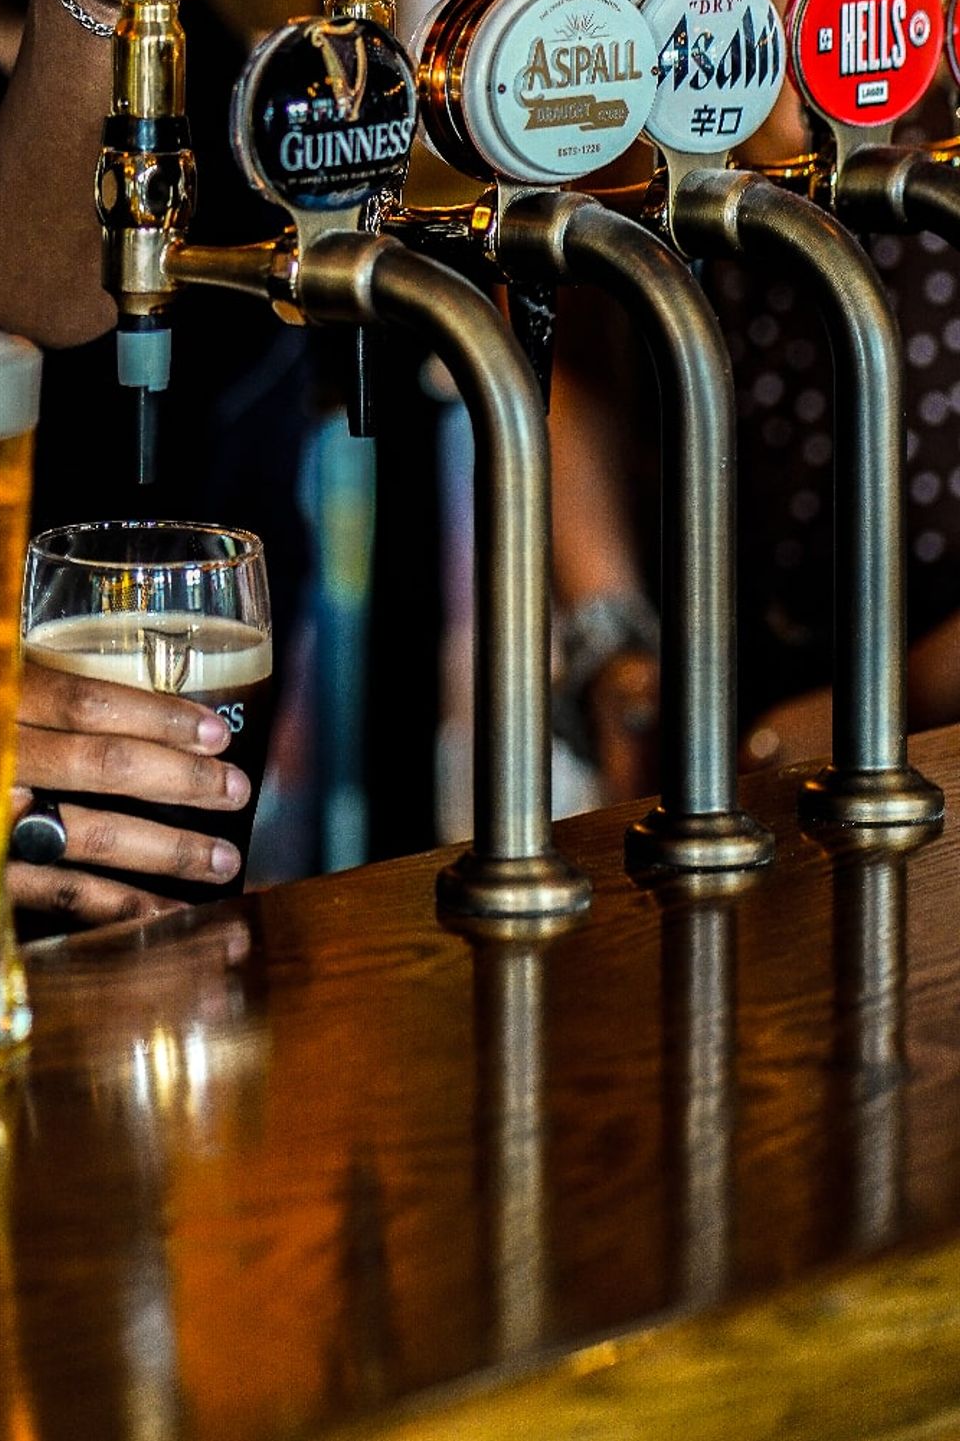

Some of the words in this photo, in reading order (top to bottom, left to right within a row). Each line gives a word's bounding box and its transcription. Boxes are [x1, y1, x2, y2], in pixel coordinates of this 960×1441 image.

[518, 37, 643, 91] ASPALL
[656, 5, 780, 92] Asahi
[280, 117, 415, 172] GUINNESS
[691, 104, 743, 137] 辛口
